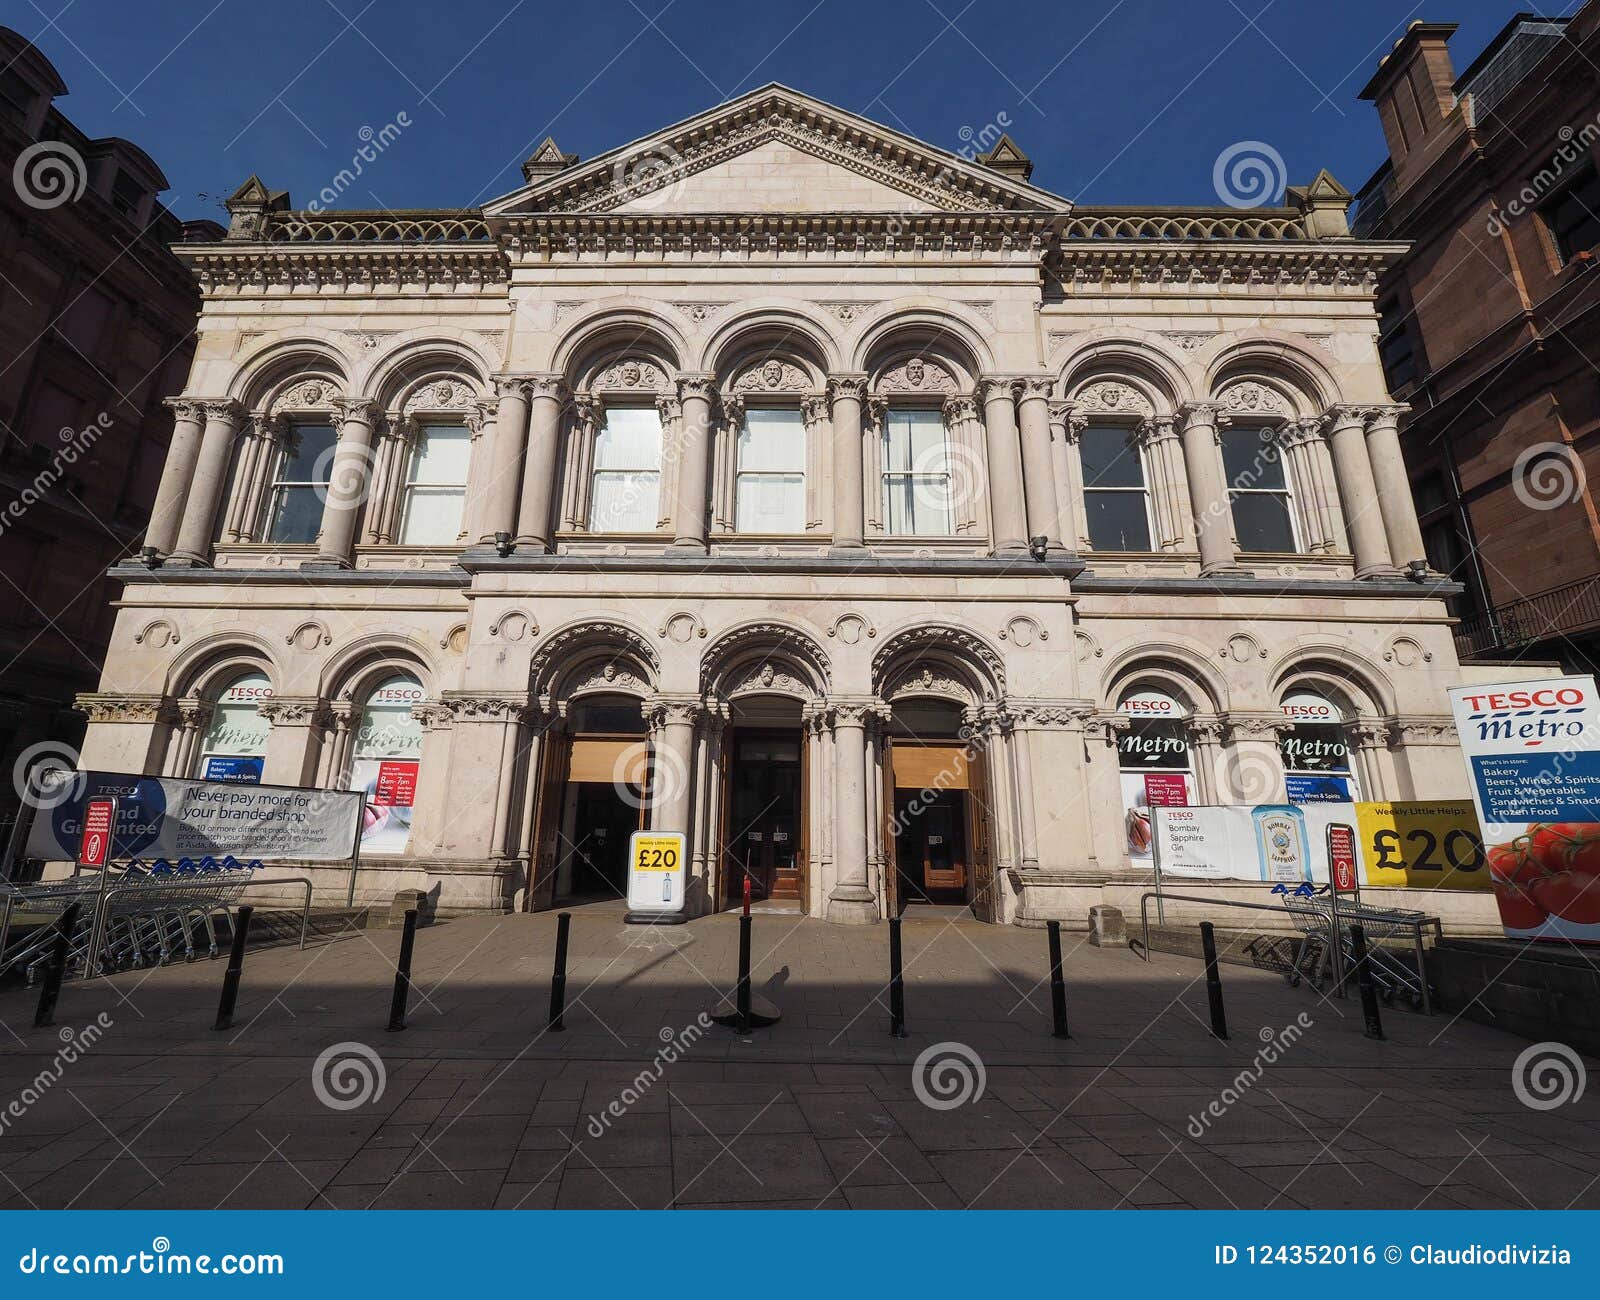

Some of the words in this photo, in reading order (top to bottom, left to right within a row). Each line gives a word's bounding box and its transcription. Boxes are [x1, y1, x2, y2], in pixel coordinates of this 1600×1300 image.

[231, 687, 273, 697] TESCO
[378, 689, 422, 699] TESCO
[1462, 688, 1584, 712] TESCO
[1122, 701, 1171, 710] TESCO
[1281, 706, 1329, 715] TESCO
[1477, 719, 1584, 740] Metro
[1119, 735, 1185, 753] Metro
[1284, 738, 1346, 756] Metro
[1483, 768, 1519, 777] Bakery
[1486, 778, 1518, 787] Beers,
[1519, 777, 1552, 785] Wines
[1554, 776, 1564, 784] &
[1565, 775, 1600, 785] Spirits
[98, 785, 138, 796] TESCO
[1488, 788, 1513, 796] Fruit
[1514, 788, 1522, 796] &
[1522, 787, 1586, 797] Vegetables
[186, 787, 227, 801] Never
[230, 793, 255, 807] pay
[258, 795, 291, 806] more
[294, 794, 311, 807] for
[1490, 797, 1554, 806] Sandwiches
[1556, 797, 1565, 805] &
[182, 808, 216, 821] your
[219, 806, 275, 820] branded
[277, 810, 306, 823] shop
[1375, 808, 1407, 817] Weekly
[1409, 807, 1434, 815] Little
[1437, 807, 1466, 816] Helps
[1492, 808, 1528, 816] Frozen
[1531, 807, 1559, 816] Food
[179, 824, 194, 833] Buy
[1169, 825, 1200, 833] Bombay
[223, 834, 240, 842] your
[1170, 834, 1204, 843] Sapphire
[1373, 829, 1485, 872] £20
[639, 850, 676, 867] £20
